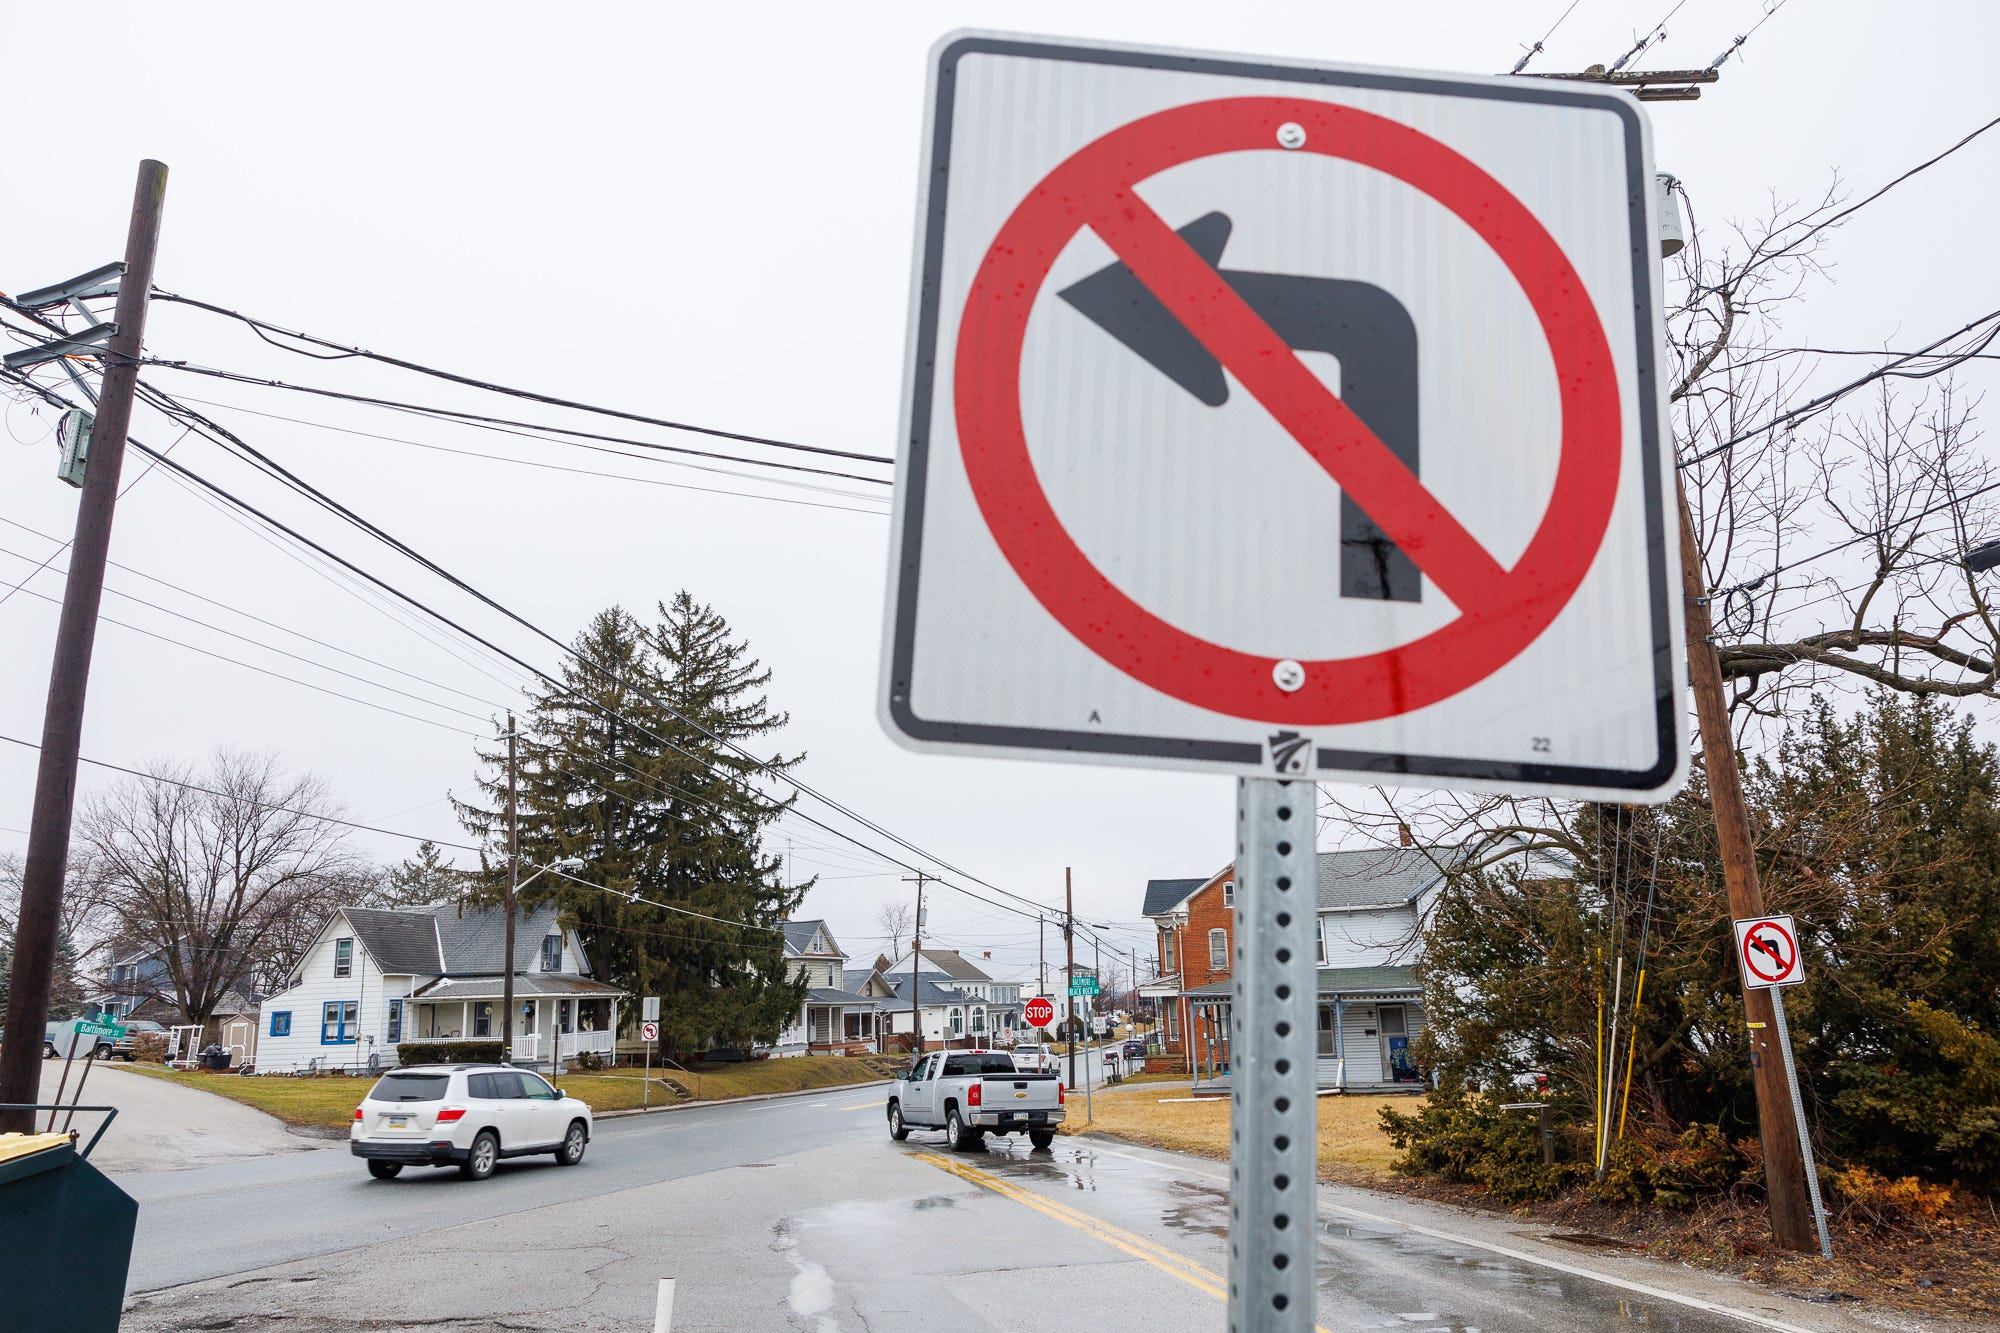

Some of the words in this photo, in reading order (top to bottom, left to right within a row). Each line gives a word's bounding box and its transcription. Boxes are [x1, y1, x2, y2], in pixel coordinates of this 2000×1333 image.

[1088, 710, 1102, 723] A
[1531, 736, 1551, 752] 22
[1069, 987, 1081, 996] BLACK
[1083, 987, 1093, 995] ROCK
[1026, 1006, 1052, 1018] STOP
[80, 1023, 113, 1036] Baltimore
